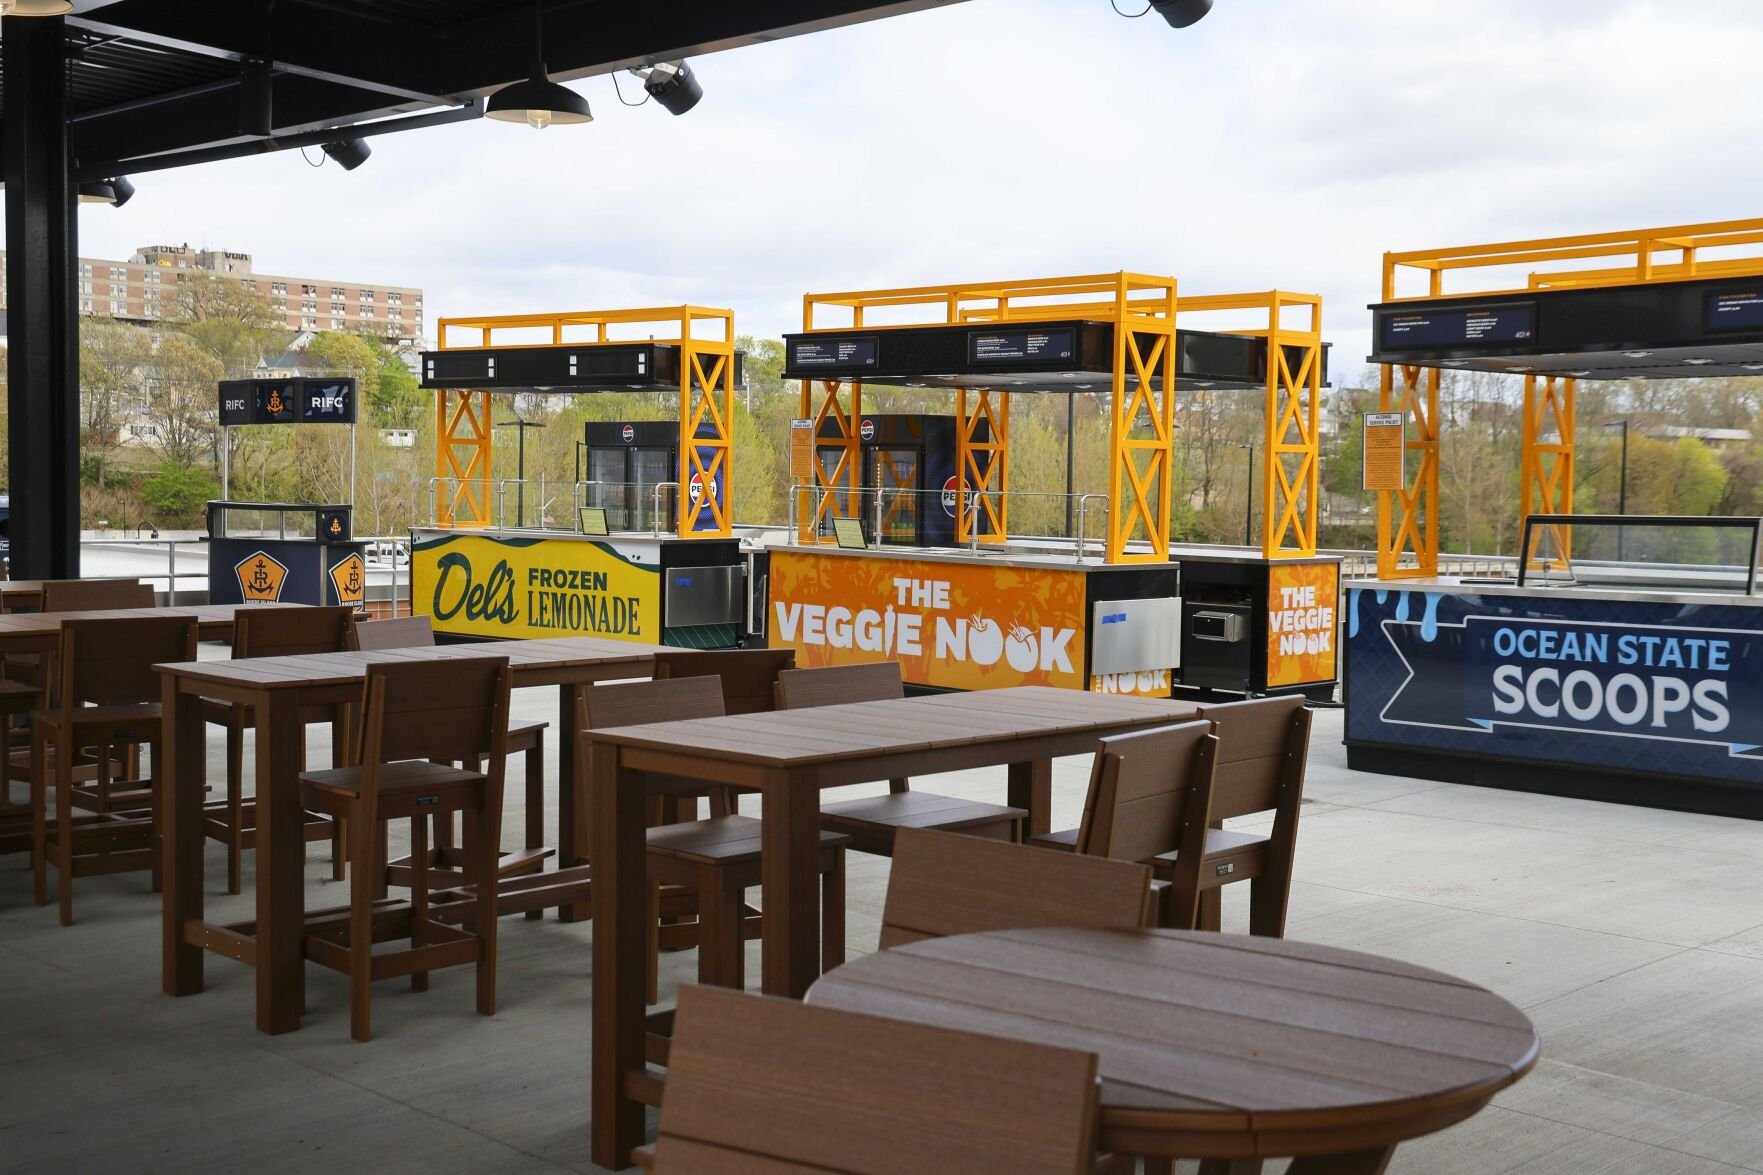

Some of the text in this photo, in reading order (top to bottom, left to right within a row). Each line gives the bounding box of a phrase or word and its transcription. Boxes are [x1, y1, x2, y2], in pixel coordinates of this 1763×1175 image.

[225, 400, 245, 411] RIFC
[311, 397, 343, 408] RIFC
[861, 426, 874, 434] PEPSI
[433, 552, 519, 624] Del's
[528, 567, 608, 591] FROZEN
[893, 578, 950, 610] THE
[1280, 586, 1316, 608] THE
[527, 590, 641, 636] LEMONADE
[1269, 604, 1333, 633] VEGGIE
[775, 602, 1076, 674] VEGGIE NOOK
[1280, 630, 1332, 656] NOOK
[1493, 627, 1730, 671] OCEAN STATE
[1102, 669, 1168, 694] NOOK
[1492, 664, 1731, 733] SCOOPS
